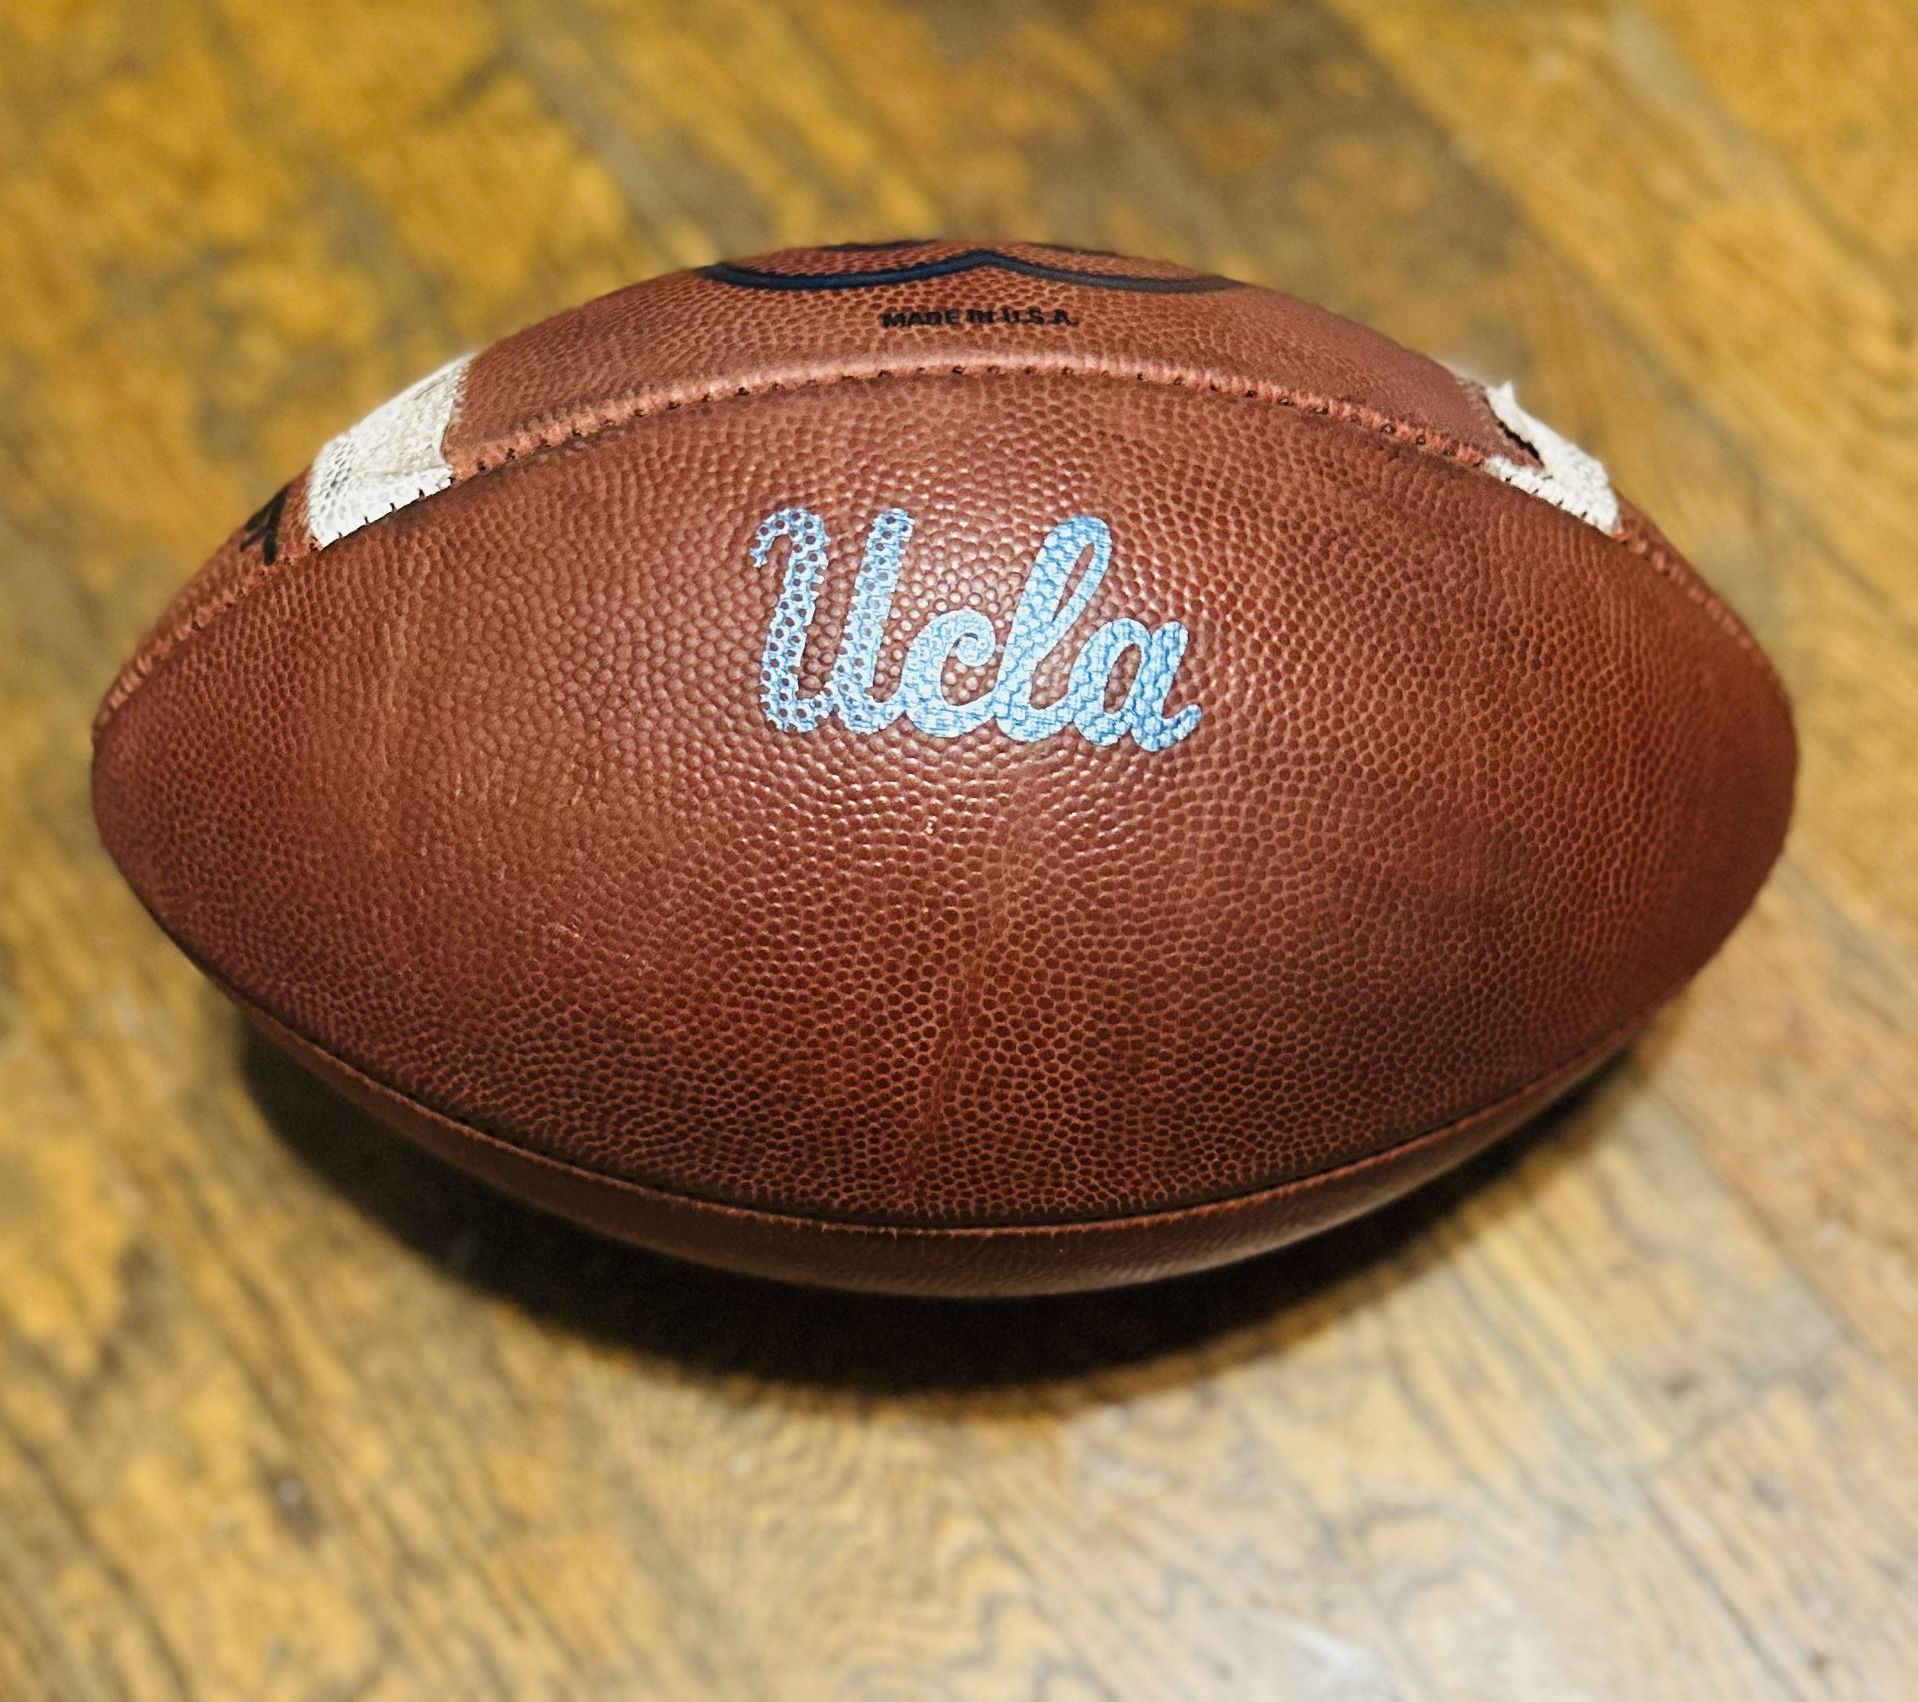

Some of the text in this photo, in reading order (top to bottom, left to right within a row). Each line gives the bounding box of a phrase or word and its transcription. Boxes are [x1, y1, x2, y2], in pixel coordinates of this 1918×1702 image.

[880, 309, 960, 328] MADE
[966, 308, 995, 325] IN
[750, 508, 1203, 752] Ucla
